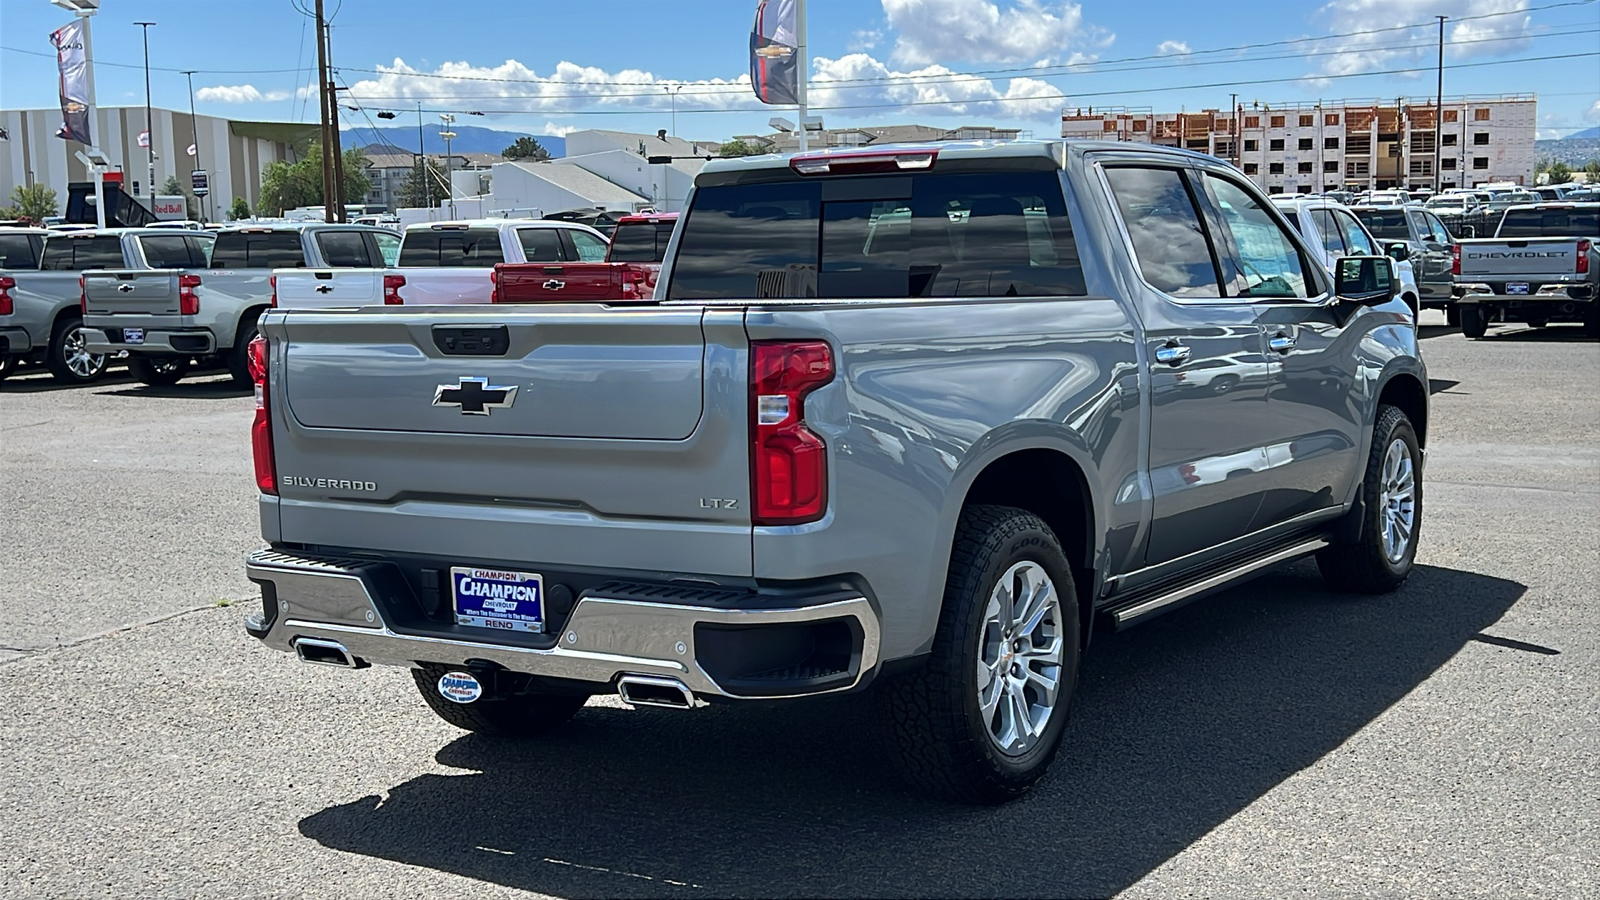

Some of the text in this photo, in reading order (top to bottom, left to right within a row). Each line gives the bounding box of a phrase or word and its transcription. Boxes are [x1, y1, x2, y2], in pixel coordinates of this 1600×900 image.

[154, 204, 182, 213] Red Bull
[1468, 251, 1568, 259] CHEVROLET
[283, 475, 377, 491] SILVERADO
[700, 498, 738, 509] LTZ
[474, 570, 517, 581] CHAMPION
[460, 577, 537, 602] CHAMPION
[484, 600, 515, 609] CHEVROLET
[485, 620, 513, 629] RENO
